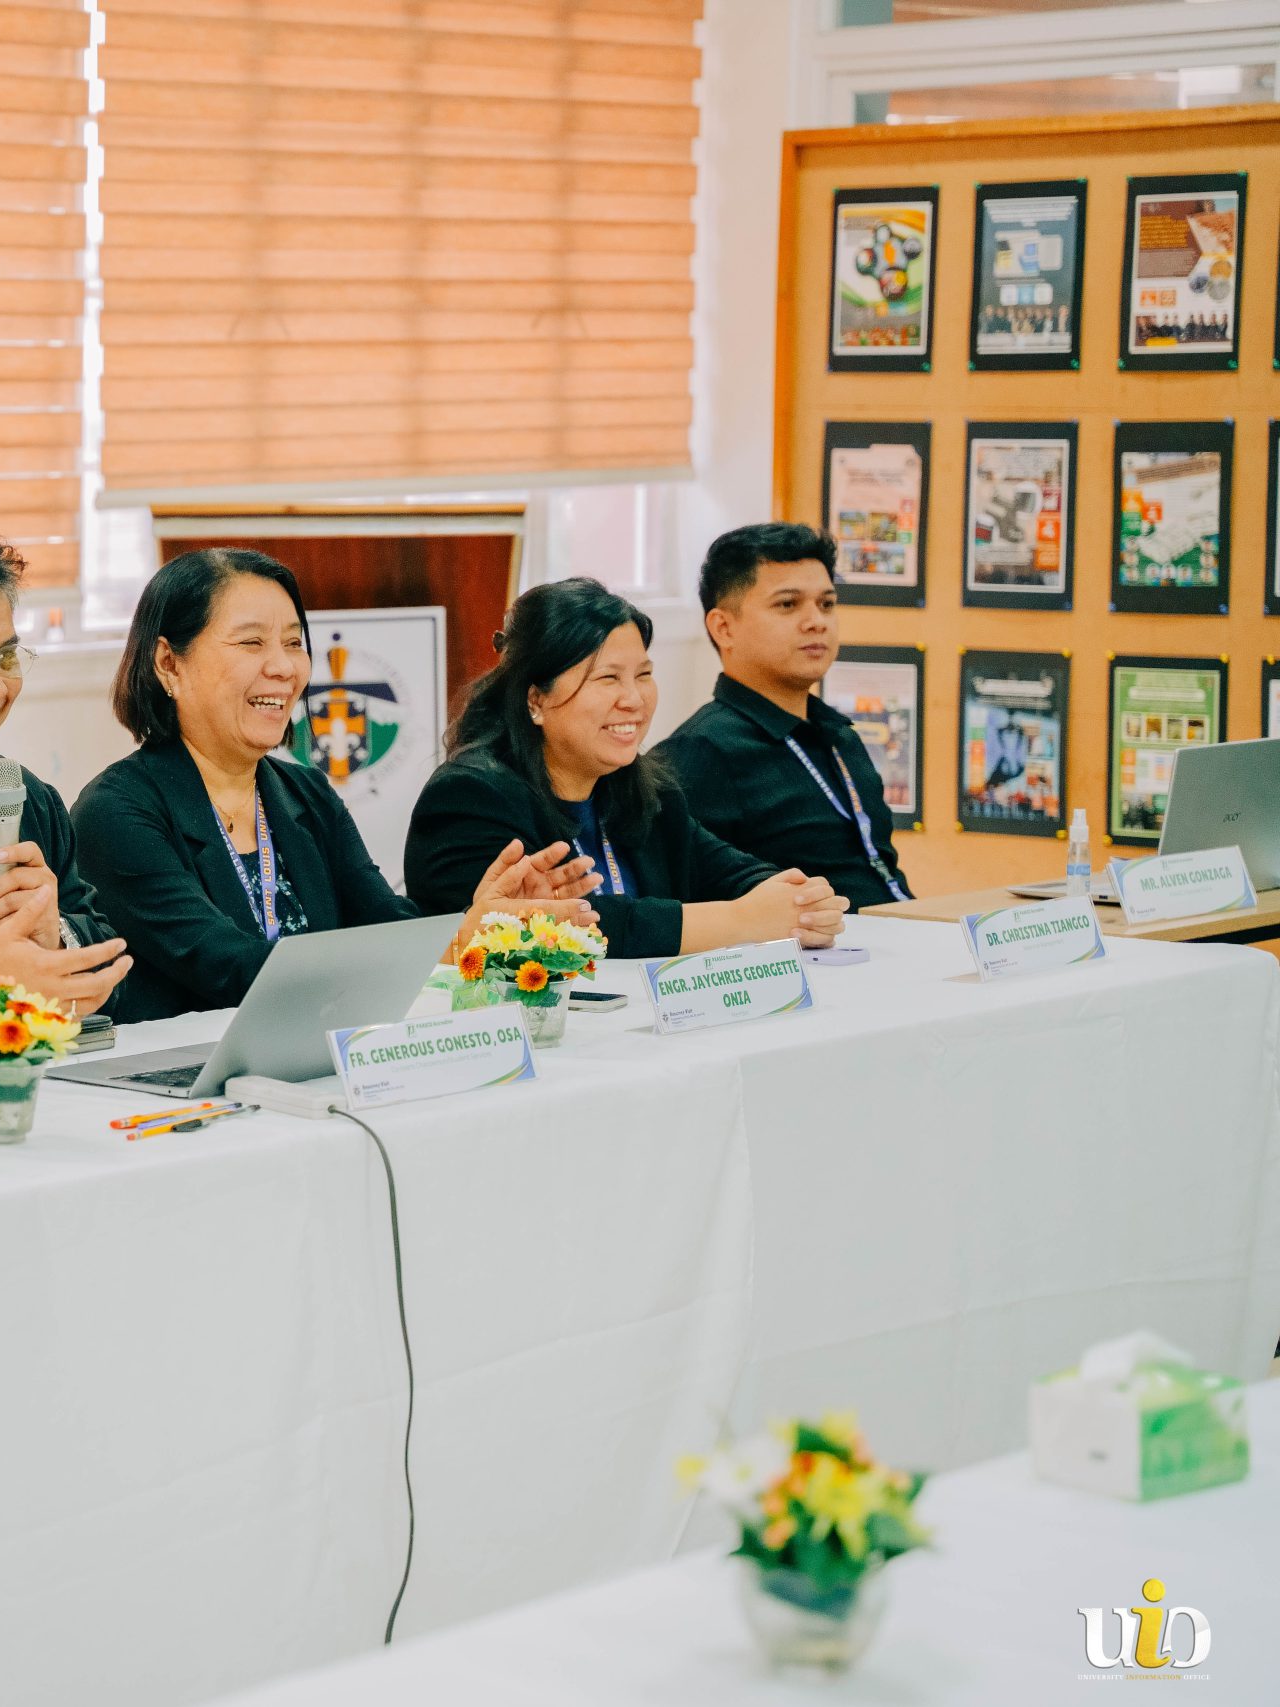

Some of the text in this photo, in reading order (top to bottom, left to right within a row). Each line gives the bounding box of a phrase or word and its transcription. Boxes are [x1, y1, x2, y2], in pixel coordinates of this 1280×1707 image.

[262, 847, 273, 882] LOUIS
[1140, 877, 1160, 892] MR.
[1160, 872, 1190, 889] ALVEN
[1189, 866, 1233, 884] GONZAGA
[264, 889, 276, 926] SAINT
[985, 932, 1003, 947] DR.
[1002, 922, 1052, 944] CHRISTINA
[1050, 914, 1090, 934] TIANGCO
[658, 959, 801, 997] ENGR. JAYCHRIS GEORGETTE
[722, 990, 752, 1008] ONIA
[349, 1052, 370, 1069] FR.
[370, 1040, 436, 1065] GENEROUS
[497, 1026, 524, 1043] OSA
